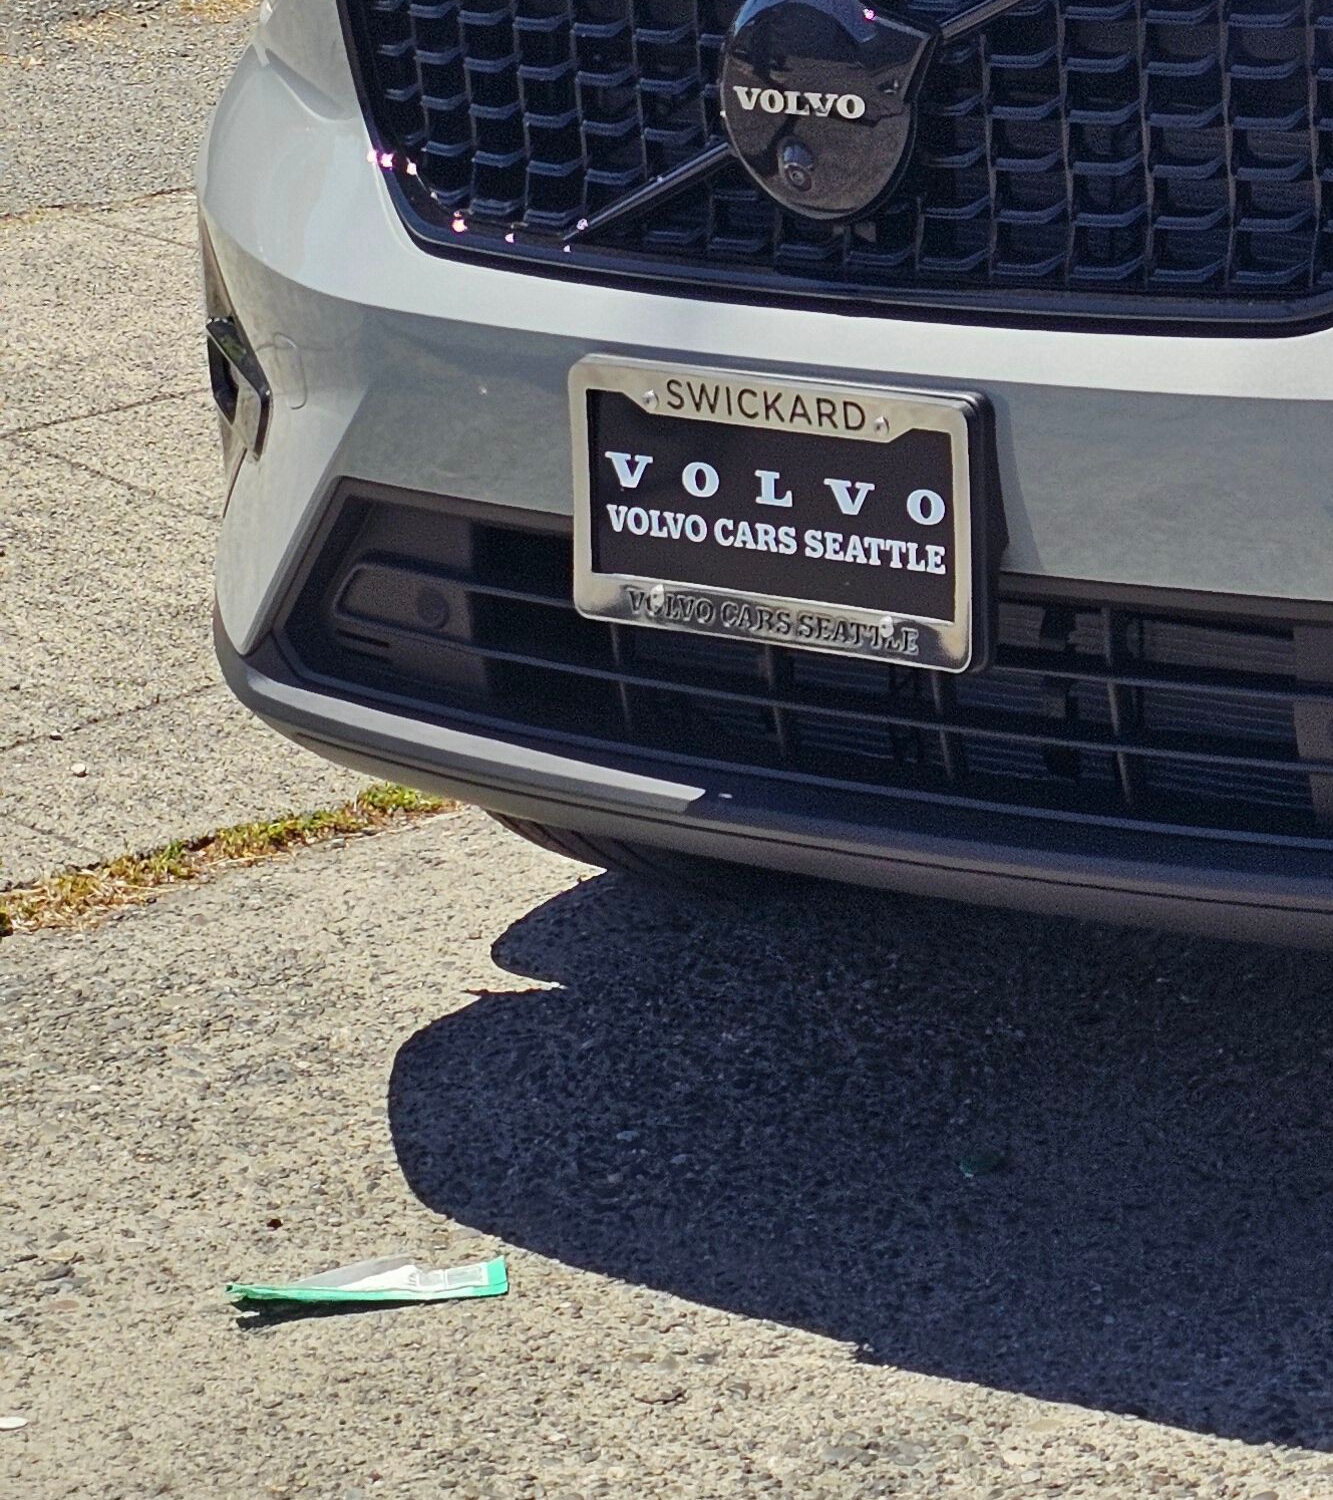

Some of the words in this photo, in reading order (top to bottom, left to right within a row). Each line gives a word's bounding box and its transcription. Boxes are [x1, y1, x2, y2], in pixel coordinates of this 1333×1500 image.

[733, 85, 866, 119] VOLVO
[665, 378, 866, 432] SWICKARD
[605, 451, 946, 526] VOLVO
[606, 503, 708, 543] VOLVO
[713, 518, 798, 555] CARS
[804, 529, 946, 575] SEATTLE
[720, 601, 792, 638] CARS
